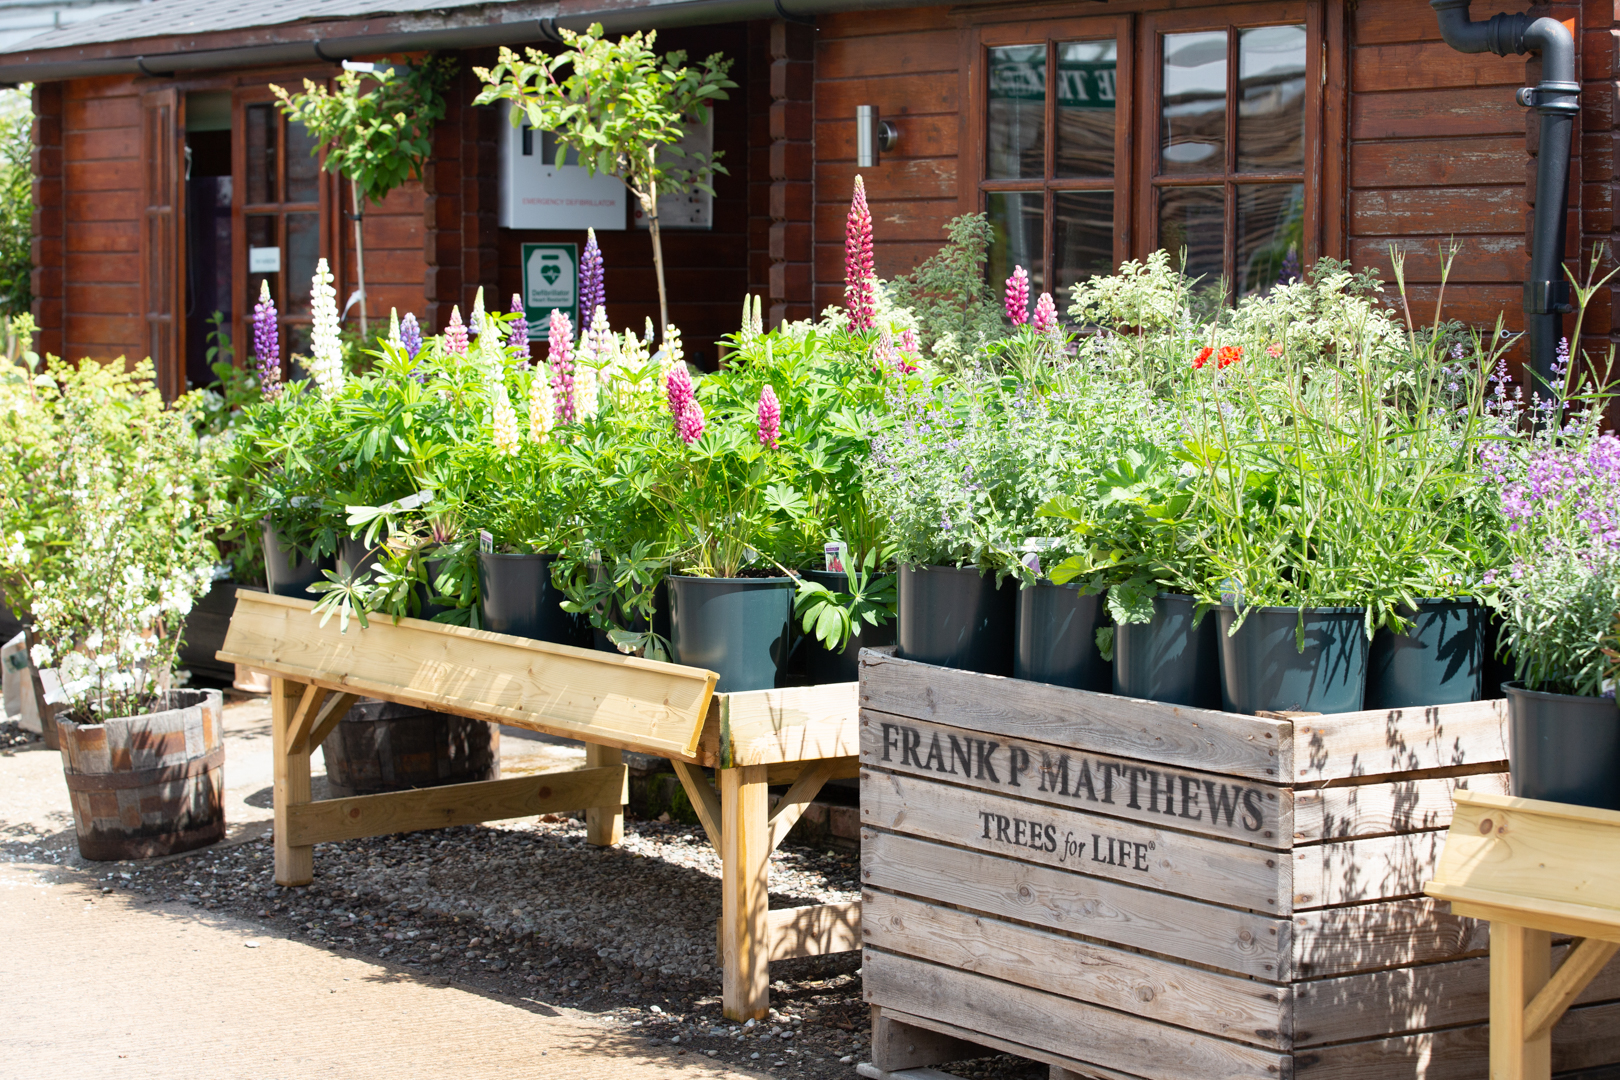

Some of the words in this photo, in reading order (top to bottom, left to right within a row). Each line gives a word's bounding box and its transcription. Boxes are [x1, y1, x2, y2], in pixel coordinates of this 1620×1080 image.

[522, 197, 564, 206] EMERGENCY
[565, 198, 616, 207] DEFIBRILLATOR
[880, 722, 1000, 784] FRANK
[1008, 745, 1030, 787] P
[1037, 749, 1264, 832] MATTHEWS
[978, 810, 1058, 853] TREES
[1059, 831, 1086, 863] for
